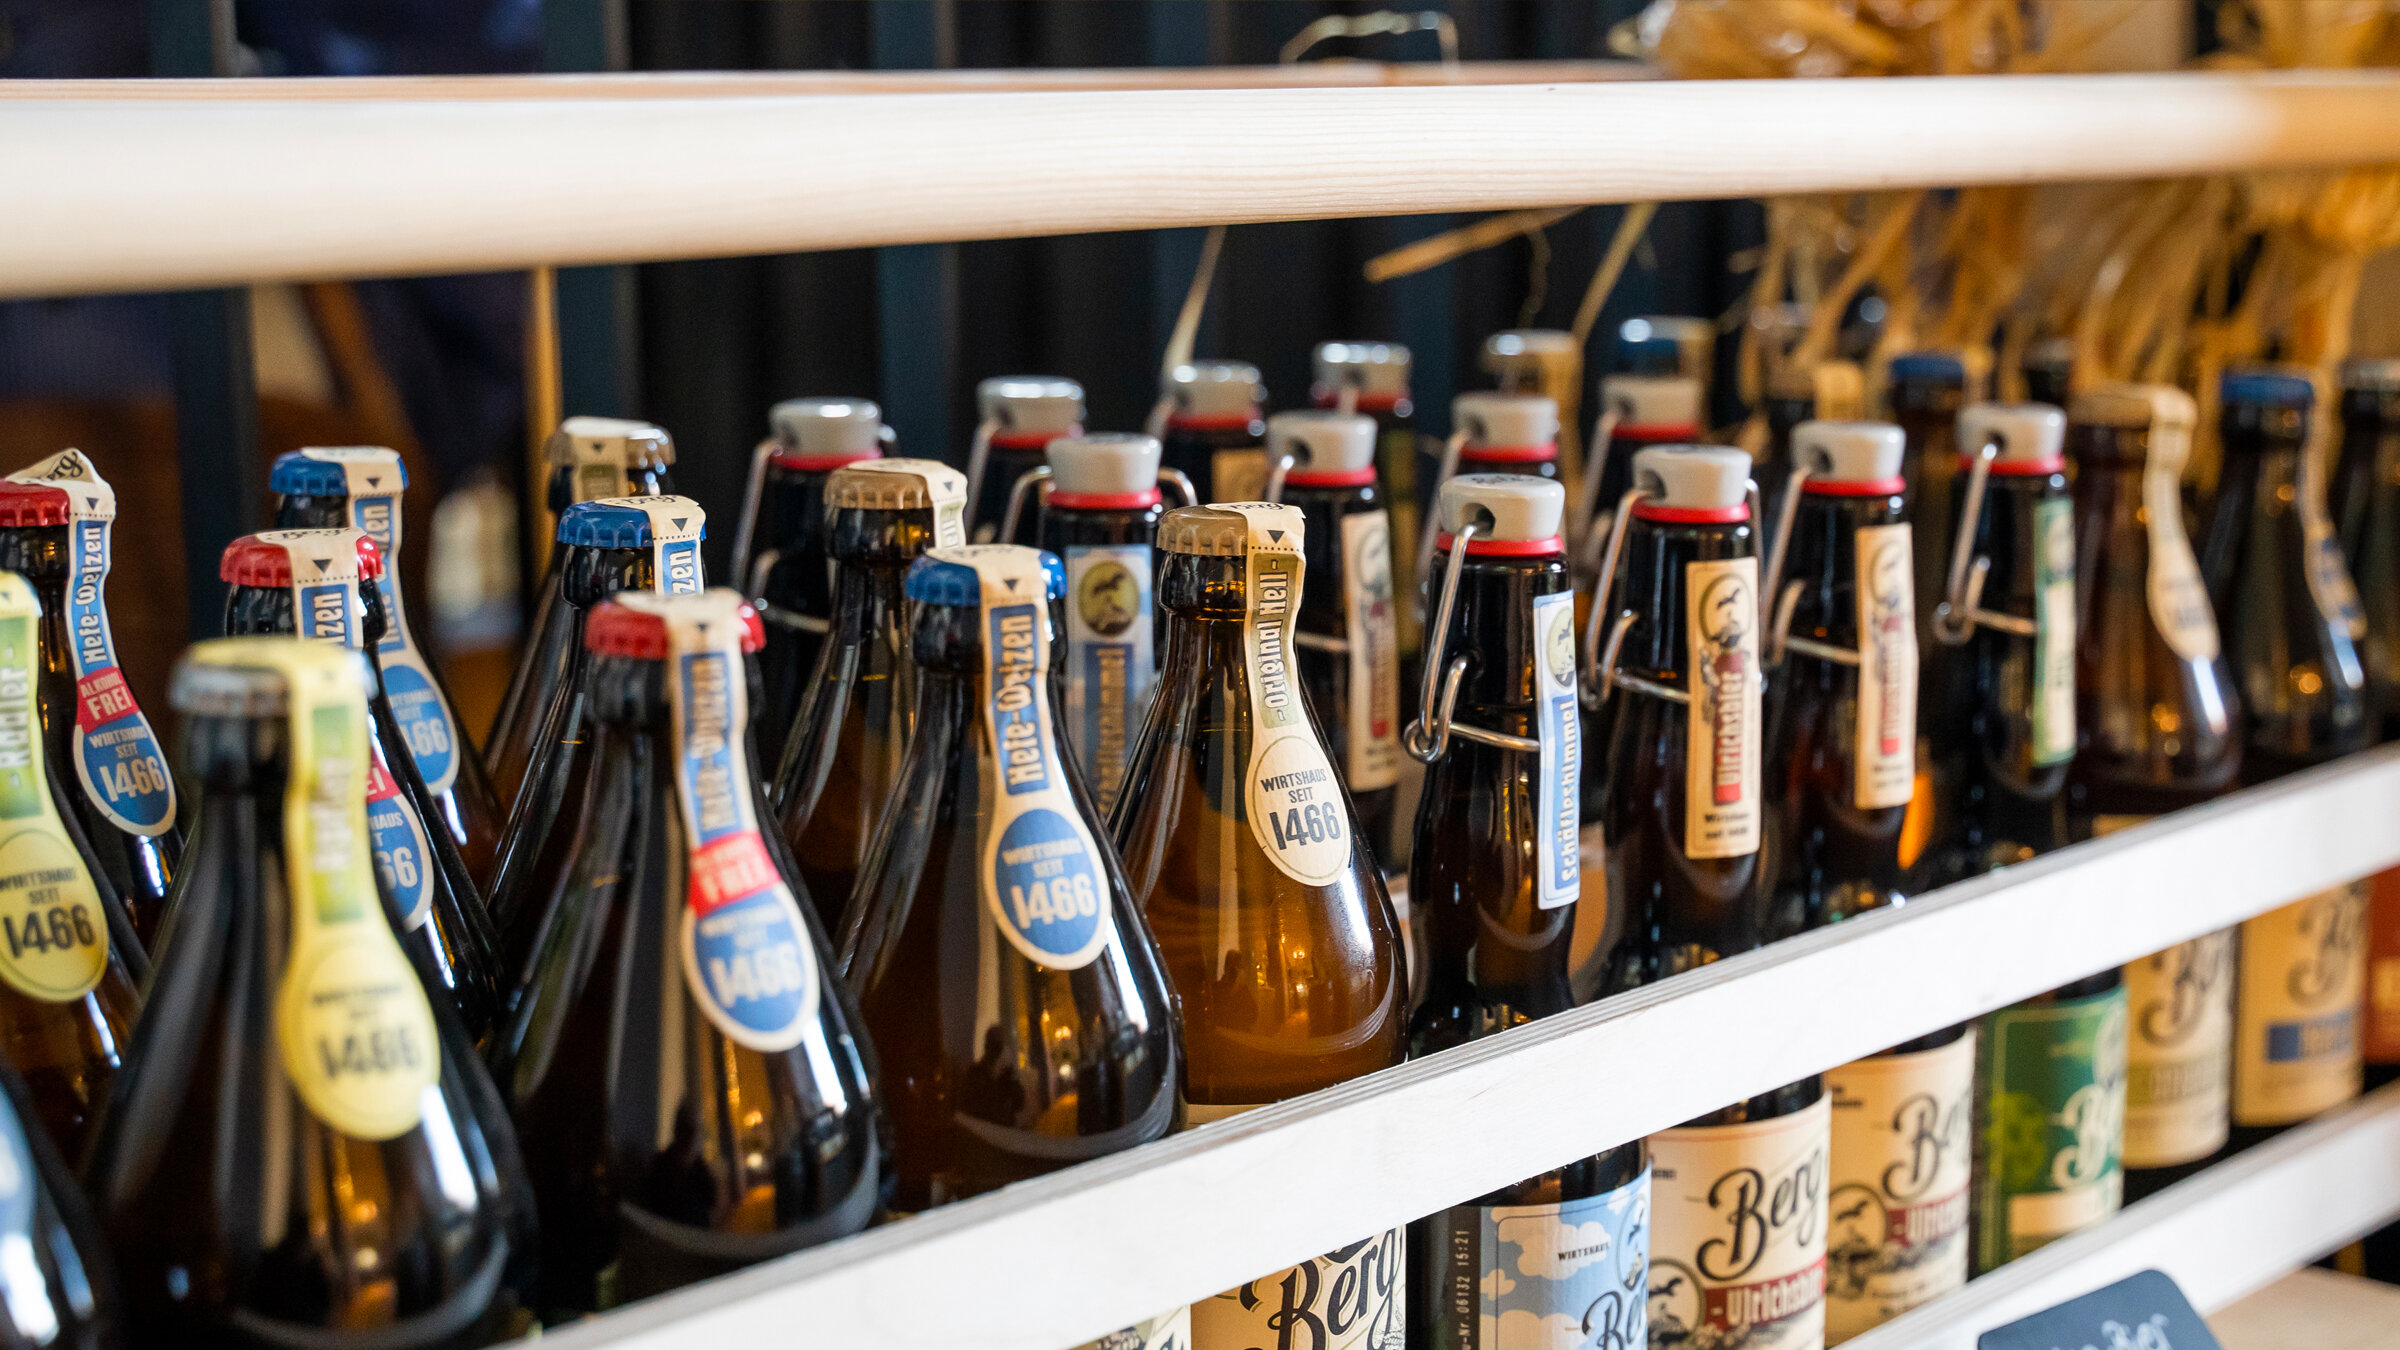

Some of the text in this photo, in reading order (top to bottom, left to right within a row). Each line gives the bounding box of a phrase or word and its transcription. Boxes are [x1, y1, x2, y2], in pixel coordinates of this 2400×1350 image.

[75, 527, 107, 664] Hefe-Weizen
[1257, 571, 1289, 709] Original Hell
[87, 686, 133, 720] FREI
[996, 614, 1045, 786] Hefe-Weizen
[99, 755, 166, 803] 1466
[1260, 768, 1327, 793] WIRTSHAUS
[1288, 787, 1314, 804] SEIT
[1269, 801, 1341, 851] 1466
[1010, 872, 1097, 930] 1466
[2, 904, 97, 959] 1466
[1695, 1148, 1822, 1282] Berg
